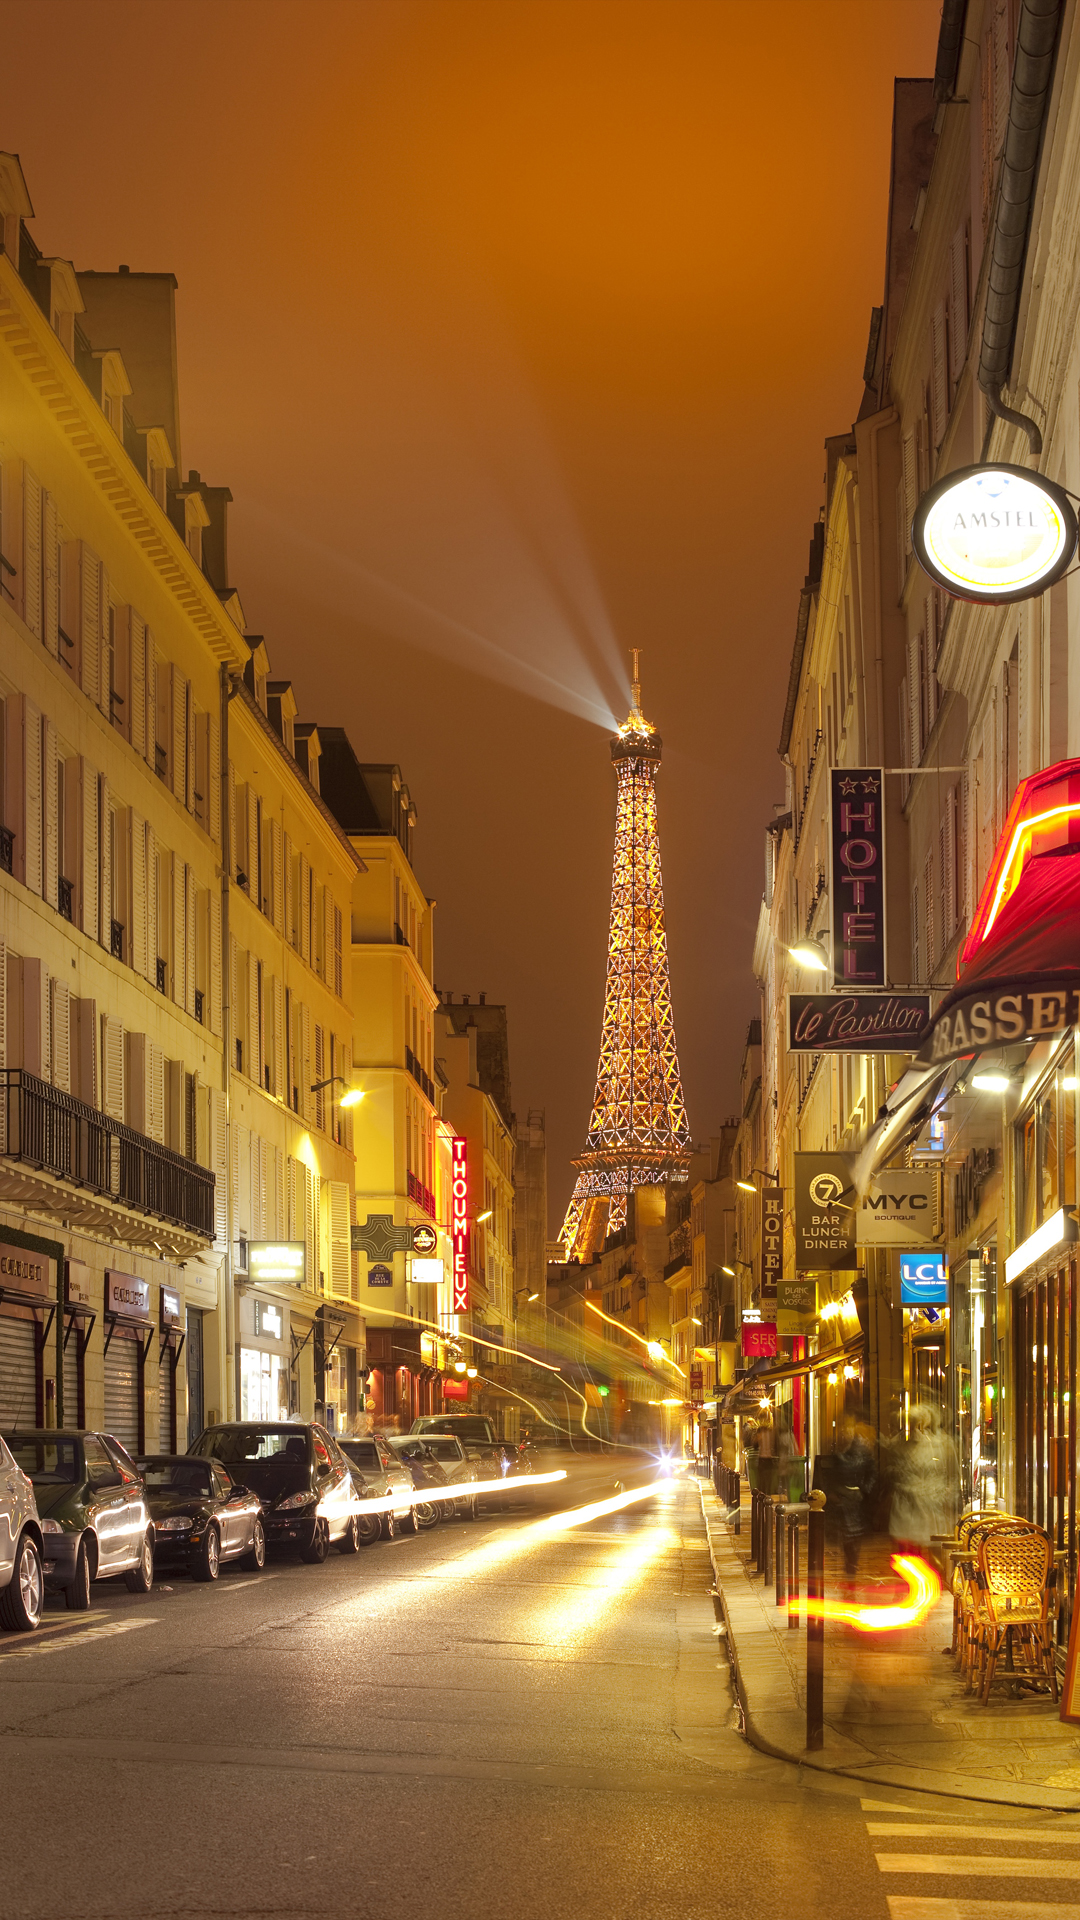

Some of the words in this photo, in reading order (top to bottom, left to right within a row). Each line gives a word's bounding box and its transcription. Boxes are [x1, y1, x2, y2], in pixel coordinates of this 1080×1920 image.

[953, 510, 1038, 530] AMSTEL
[840, 802, 878, 979] HOTEL
[827, 997, 924, 1038] Pavillon
[931, 989, 1080, 1058] BRASSE
[819, 1183, 834, 1200] 7
[863, 1194, 928, 1210] MYC
[452, 1140, 468, 1310] THOUMIEUX
[812, 1215, 840, 1225] BAR
[802, 1227, 850, 1237] LUNCH
[764, 1199, 780, 1287] HOTEL
[805, 1240, 848, 1249] DINER
[903, 1264, 949, 1281] LCL
[784, 1287, 809, 1297] BLANC
[782, 1298, 812, 1306] VOSGES
[751, 1333, 776, 1345] SFR
